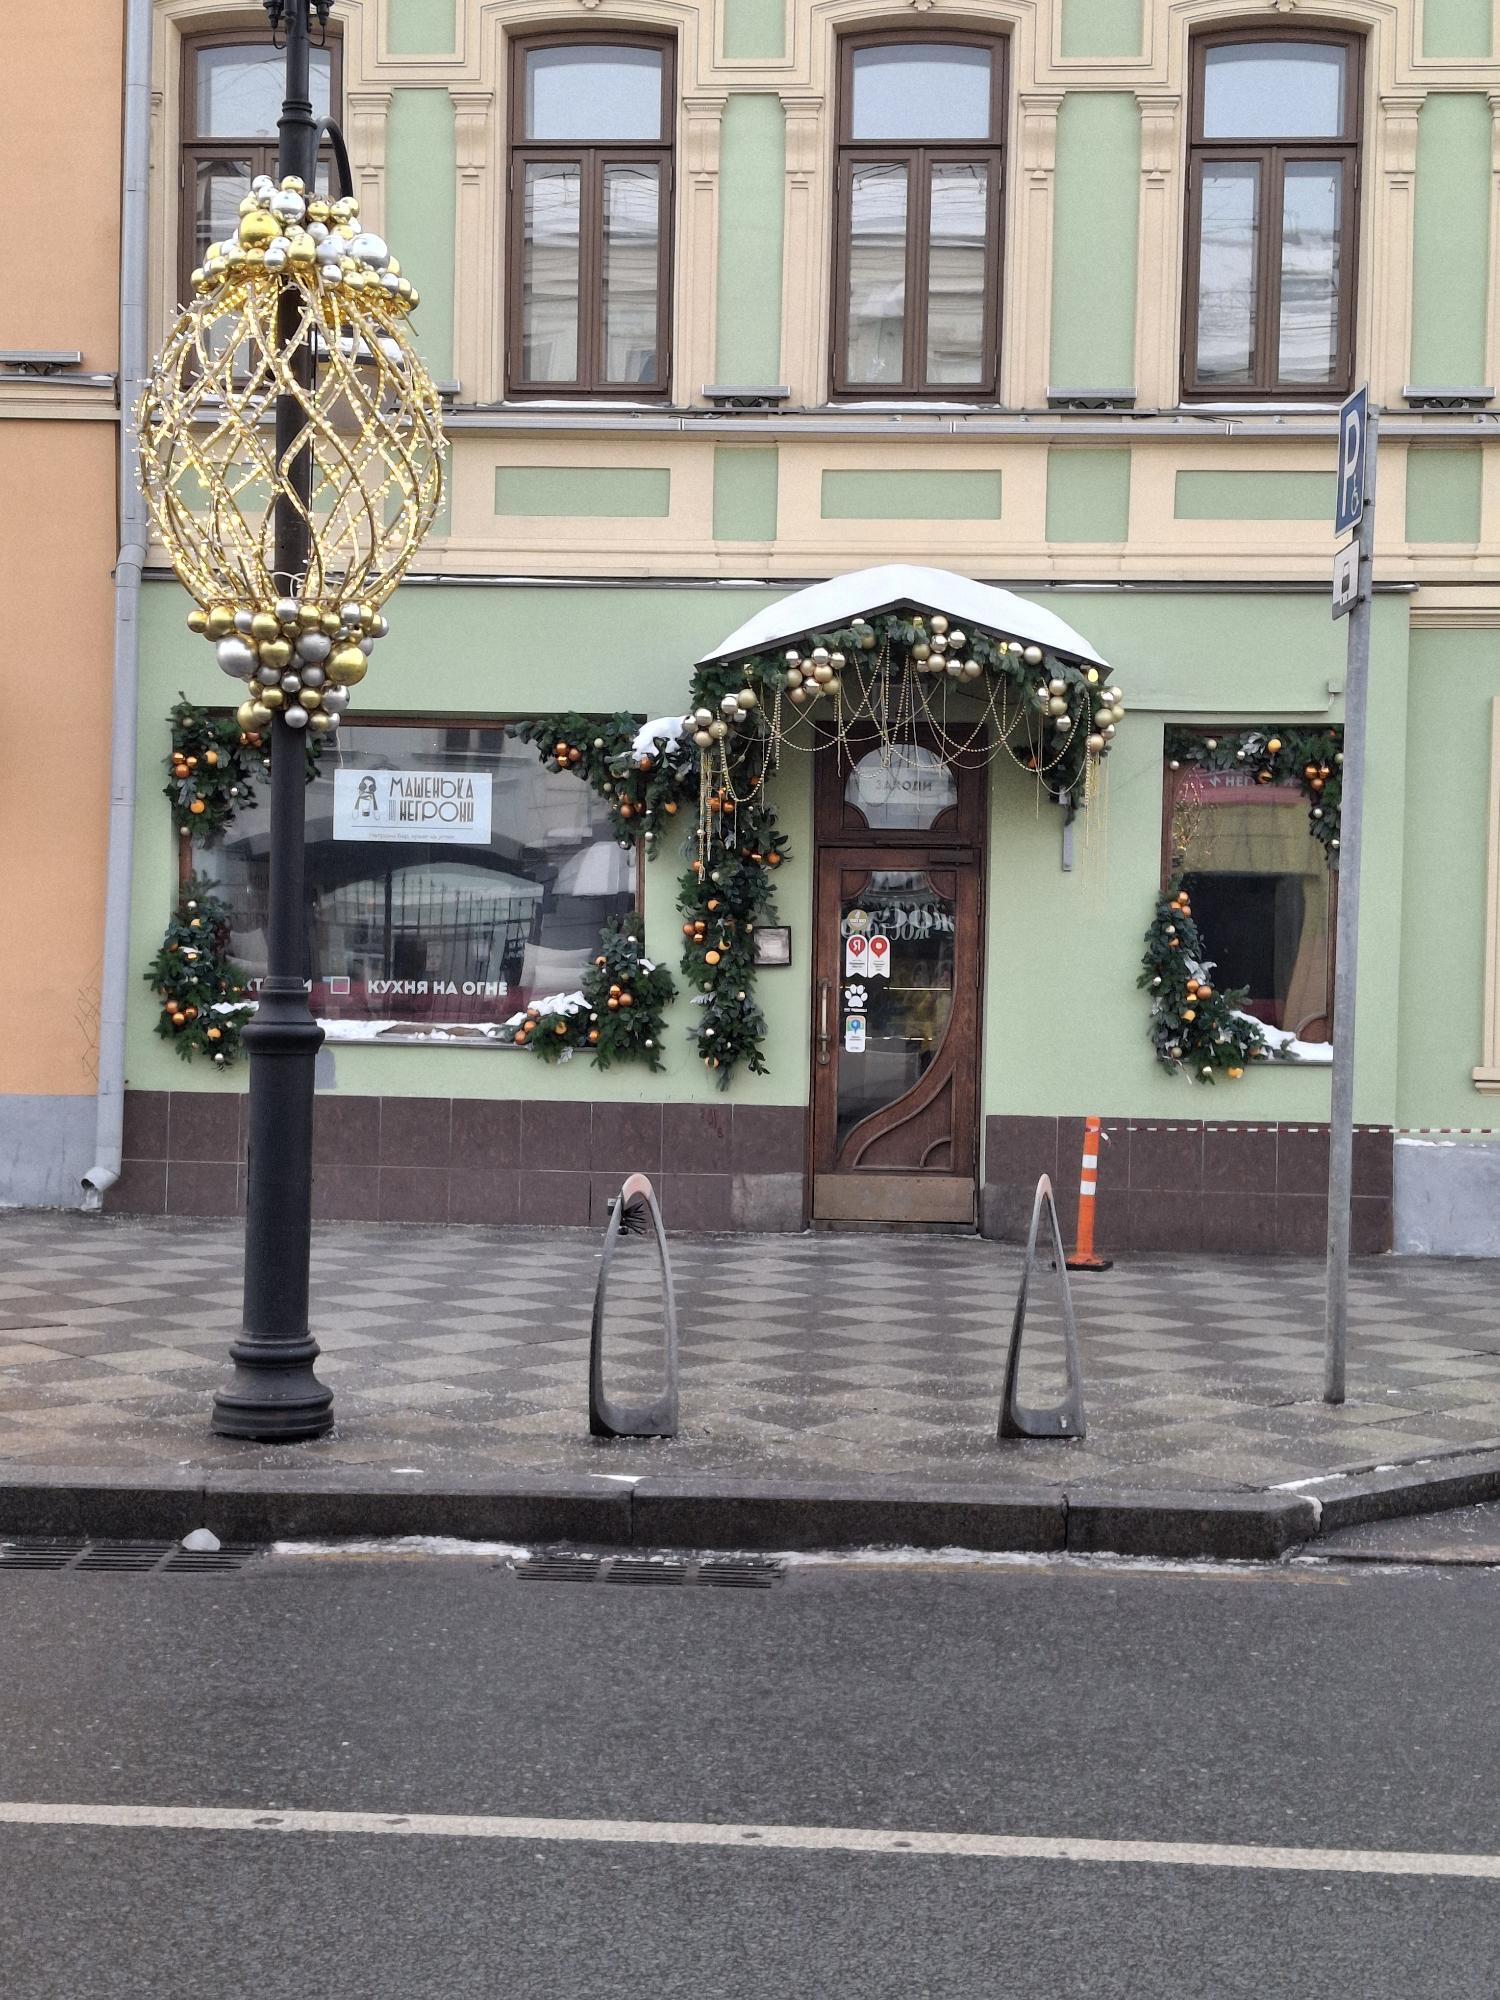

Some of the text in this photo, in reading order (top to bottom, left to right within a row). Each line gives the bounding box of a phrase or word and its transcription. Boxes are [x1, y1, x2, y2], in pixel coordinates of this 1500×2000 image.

[1341, 409, 1360, 517] P
[389, 776, 474, 799] МАШЕНЬКА
[399, 800, 474, 822] НЕГРОНИ
[368, 980, 508, 996] КУХНЯ НА ОГНЕ
